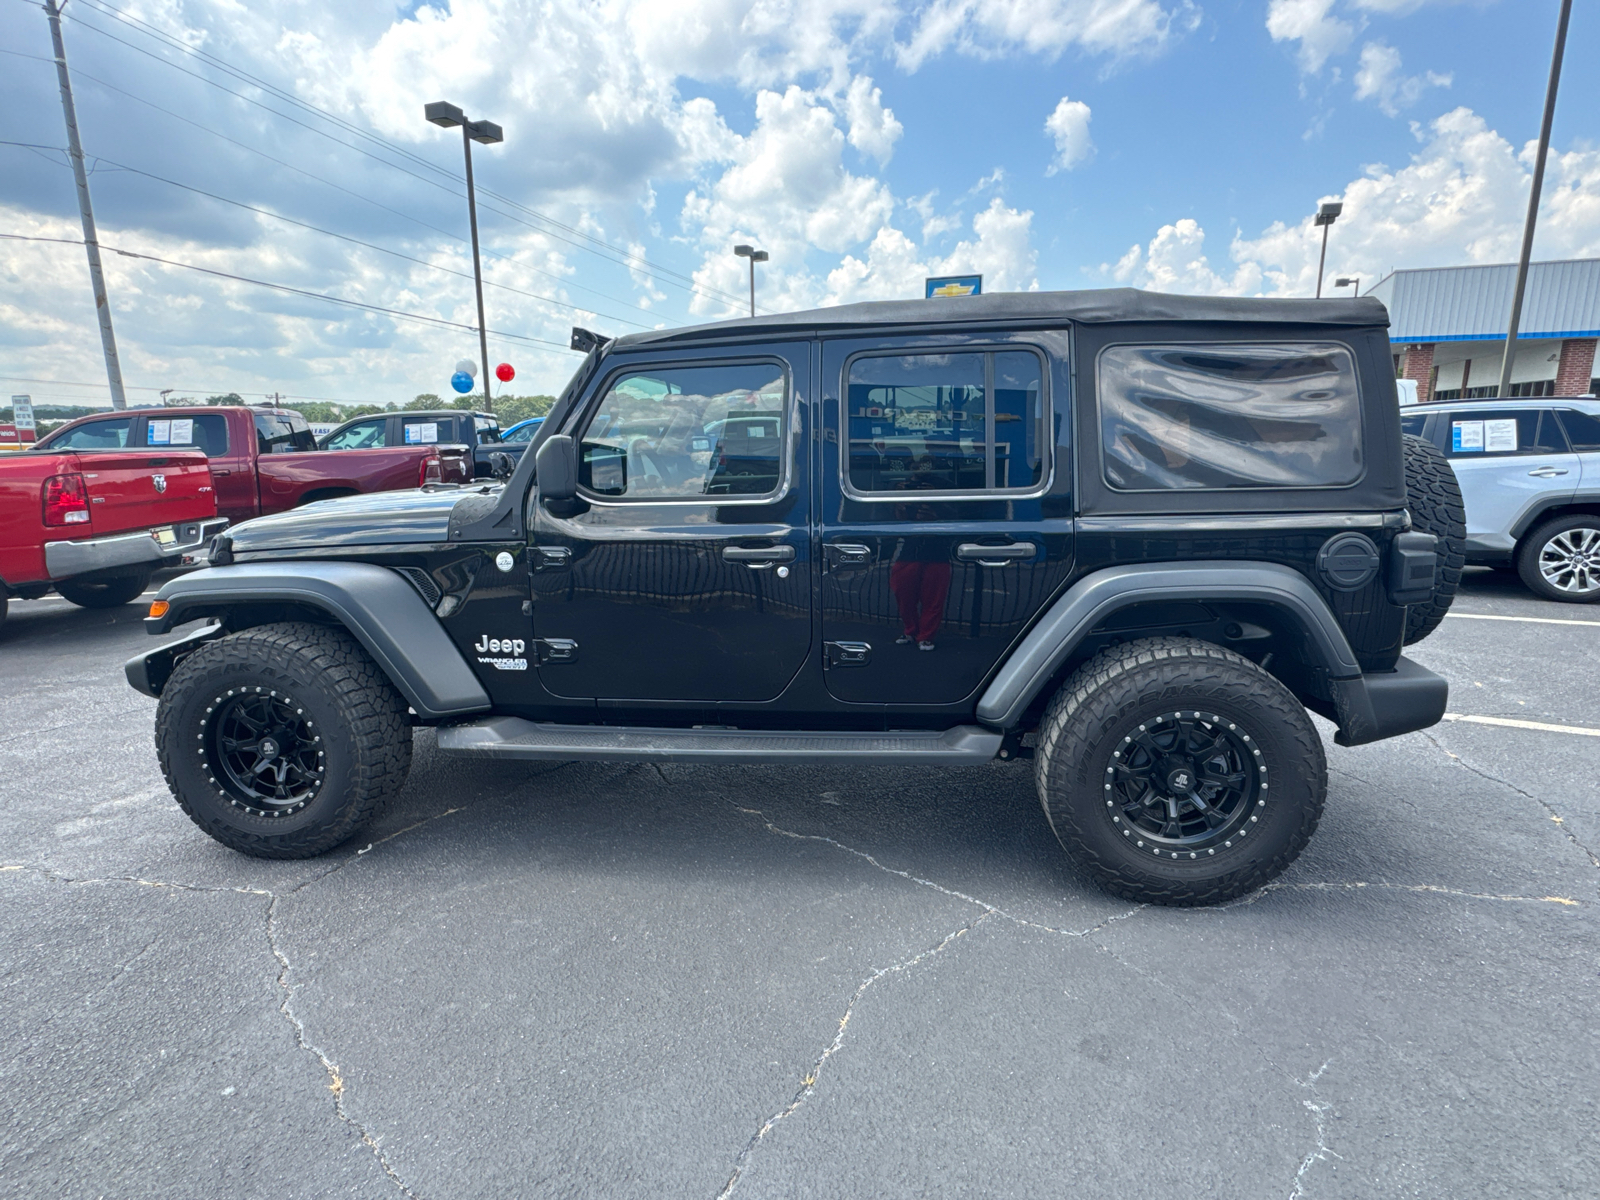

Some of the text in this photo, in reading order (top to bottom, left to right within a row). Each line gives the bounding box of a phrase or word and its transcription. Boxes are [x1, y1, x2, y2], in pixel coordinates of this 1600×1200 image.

[1339, 558, 1362, 567] Jeep
[475, 634, 525, 656] Jeep
[477, 656, 527, 664] WRANGLER
[1075, 684, 1205, 788] WILDPEAK
